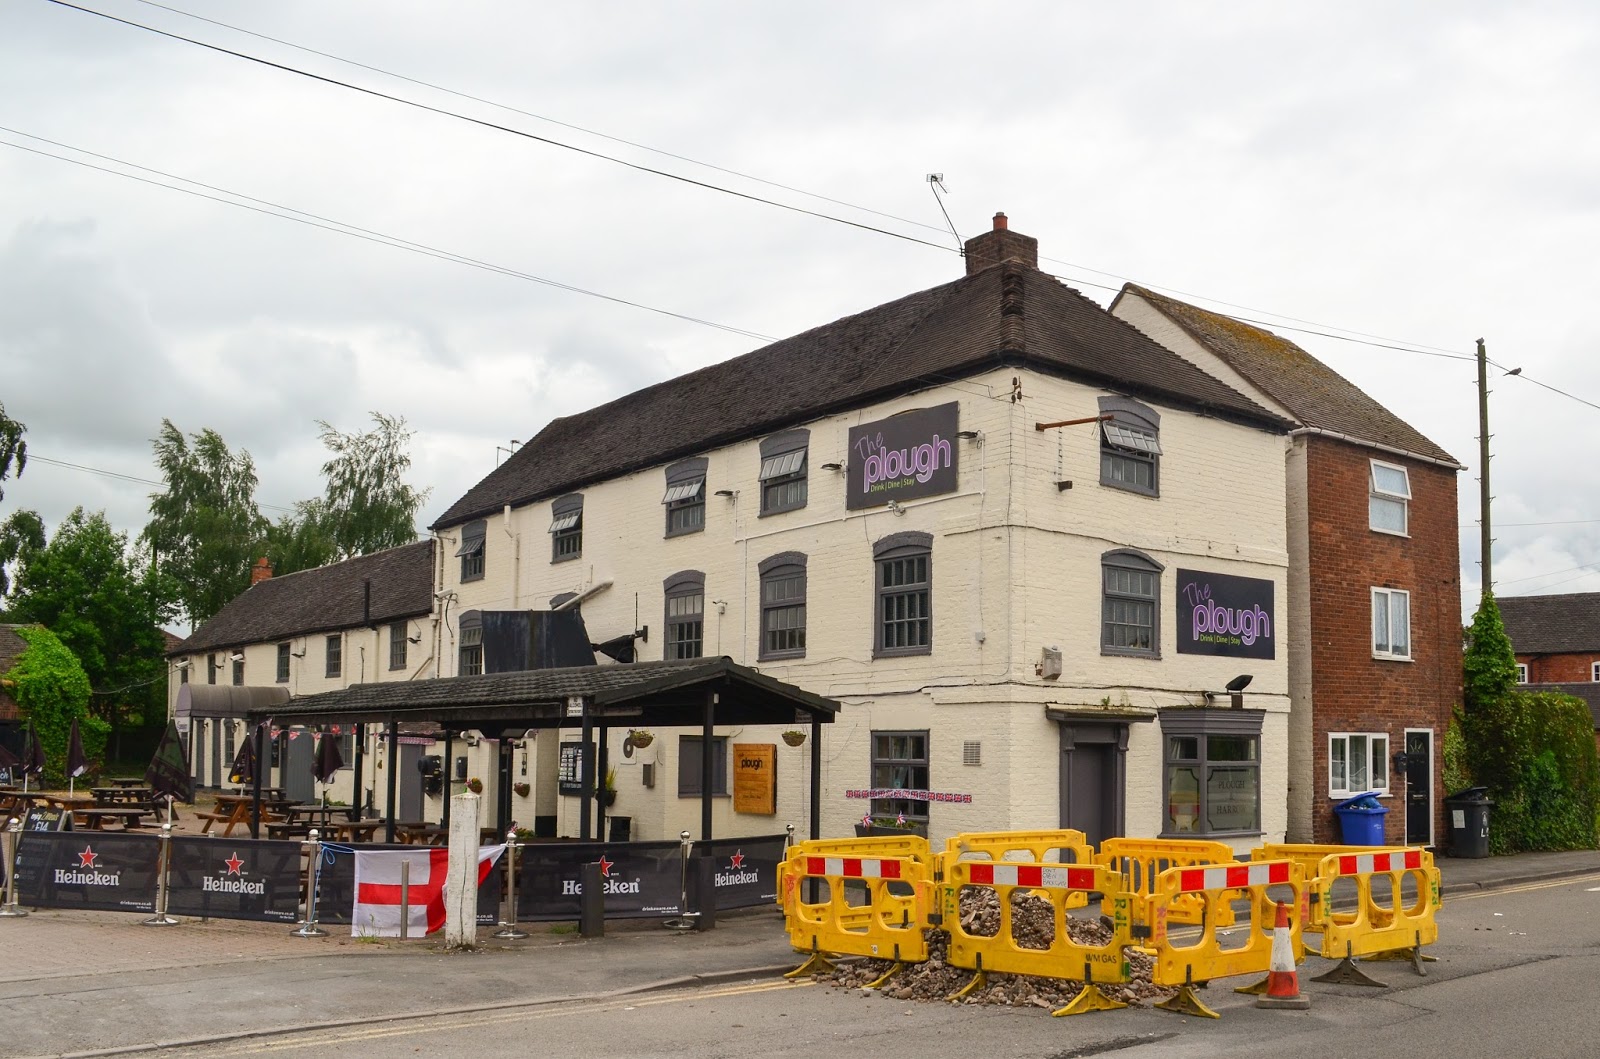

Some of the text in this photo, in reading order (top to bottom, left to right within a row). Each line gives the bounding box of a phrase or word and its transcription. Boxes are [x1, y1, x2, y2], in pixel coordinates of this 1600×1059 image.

[854, 432, 883, 460] The
[864, 434, 951, 493] plough
[870, 477, 915, 492] Drink Dine Stay
[1183, 582, 1211, 607] The
[1192, 599, 1270, 645] plough
[1200, 634, 1241, 645] Drink Dine Stay
[742, 757, 763, 770] plough
[1218, 780, 1245, 789] PLOUGH
[35, 820, 49, 831] £14
[54, 868, 120, 886] Heineken
[715, 870, 759, 887] Heineken
[203, 876, 265, 895] Heineken
[562, 879, 640, 895] Heeken
[1101, 954, 1117, 964] GAS
